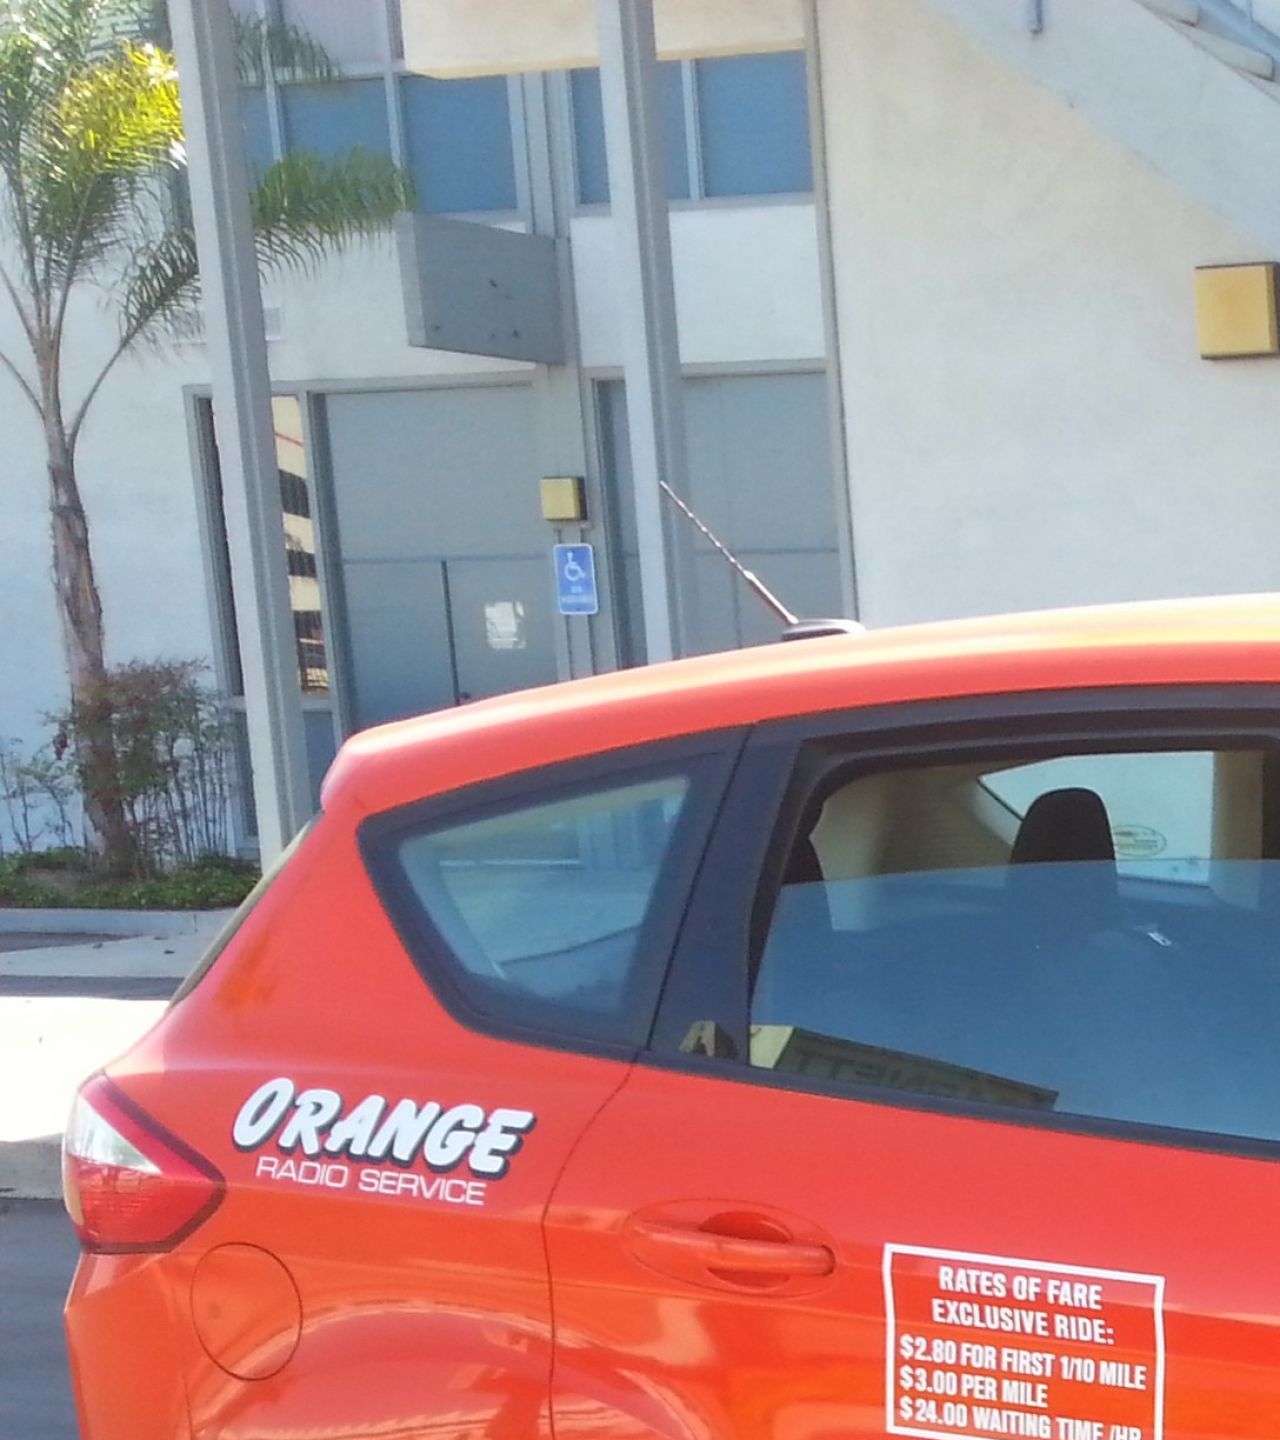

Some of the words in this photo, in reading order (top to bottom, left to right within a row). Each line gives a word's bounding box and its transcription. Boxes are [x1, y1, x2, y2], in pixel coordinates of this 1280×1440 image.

[232, 1076, 537, 1180] ORANGE
[255, 1156, 349, 1189] RADIO
[358, 1168, 488, 1207] SERVICE
[938, 1266, 1007, 1298] RATES
[1012, 1275, 1041, 1301] OF
[1047, 1278, 1102, 1310] FARE
[931, 1298, 1049, 1336] EXCLUSIVE
[1054, 1313, 1115, 1345] RIDE:
[899, 1333, 956, 1365] $2.80
[960, 1342, 997, 1370] FOR
[1001, 1347, 1055, 1378] FIRST
[1060, 1355, 1095, 1383] 1/10
[1100, 1360, 1147, 1390] MILE
[899, 1364, 957, 1396] $3.00
[961, 1372, 997, 1401] PER
[1001, 1378, 1048, 1408] MILE
[972, 1404, 1051, 1440] WAITING
